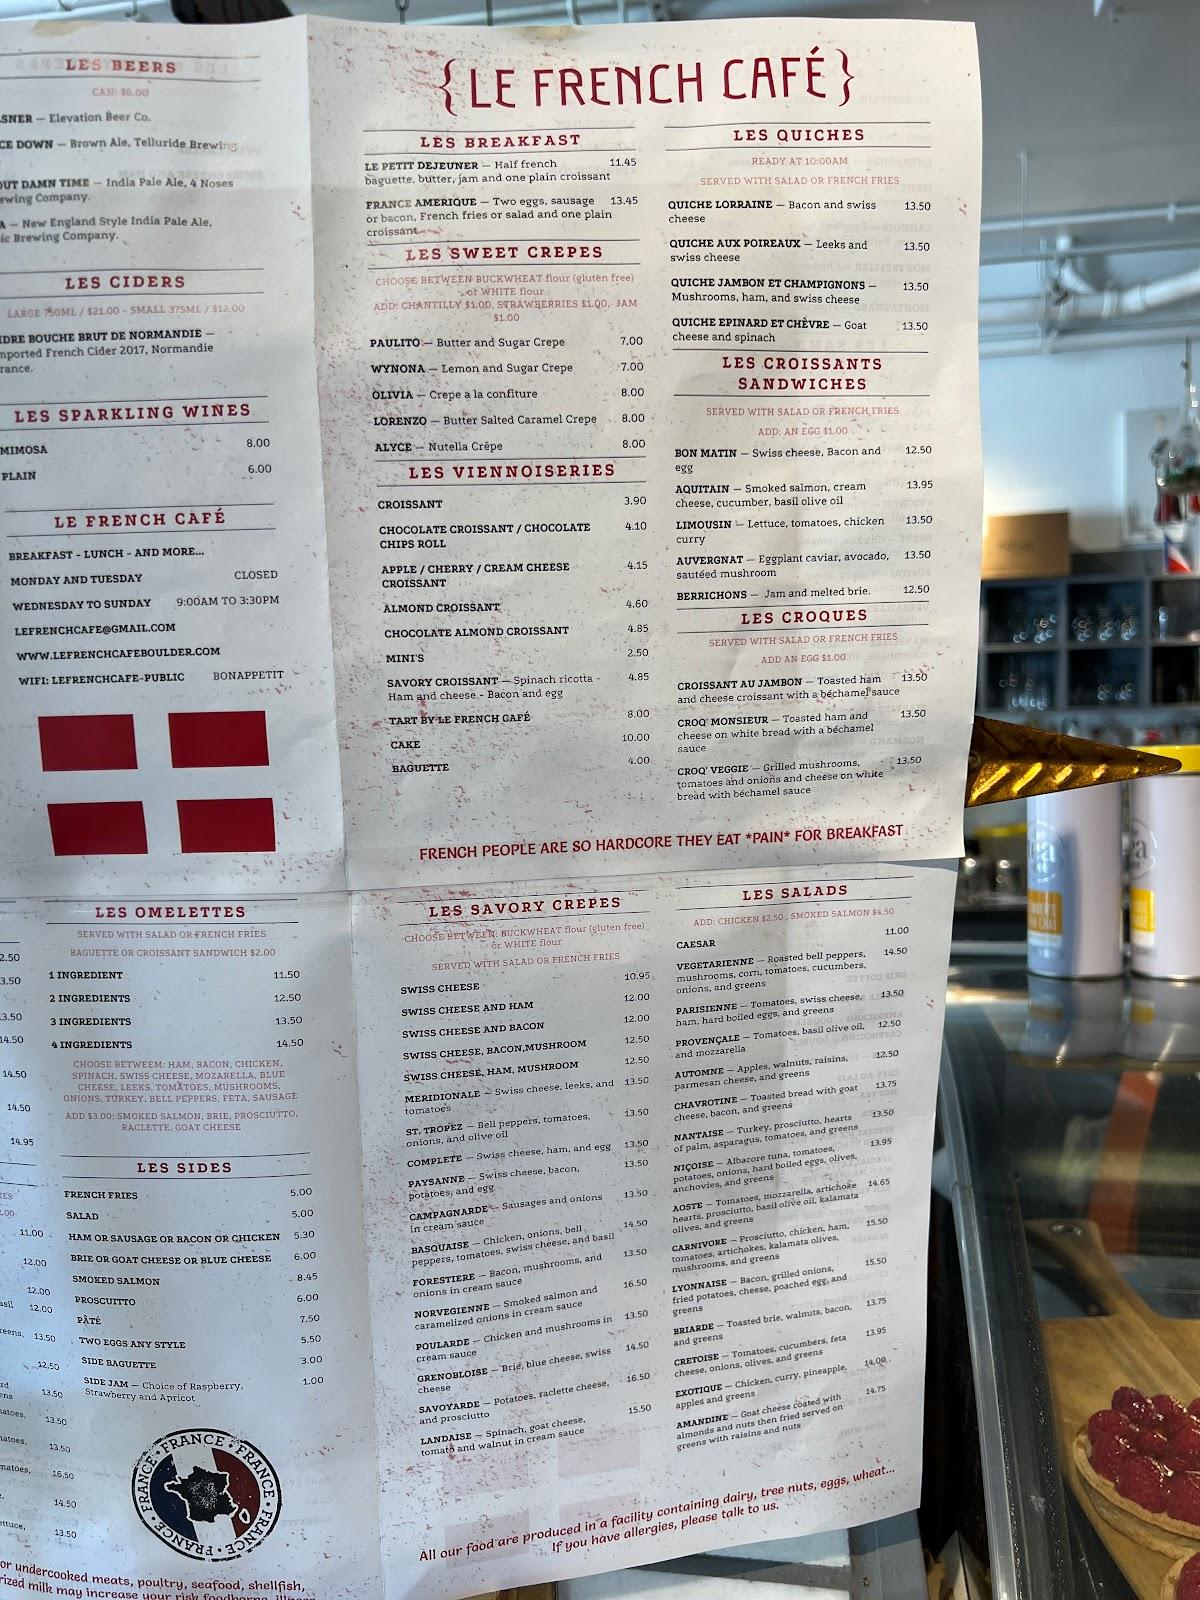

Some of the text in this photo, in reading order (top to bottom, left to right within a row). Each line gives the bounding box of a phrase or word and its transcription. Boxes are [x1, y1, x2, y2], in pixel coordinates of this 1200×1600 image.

[65, 58, 176, 74] LES BEERS
[534, 62, 703, 106] FRENCH
[48, 110, 151, 123] Elevation Beer Co.
[420, 134, 580, 149] LES BREAKFAST
[733, 128, 864, 144] LES QUICHES
[751, 155, 848, 168] READY AT 10:00AM
[667, 199, 931, 211] QUICHE LORRAINE Bacon and swiss 13.50
[406, 245, 602, 261] LES SWEET CREPES
[64, 275, 184, 290] LES CIDERS
[671, 317, 716, 328] QUICHE
[718, 317, 768, 328] EPINARD
[770, 318, 785, 328] ET
[844, 320, 867, 330] Goat
[901, 321, 928, 331] 13.50
[370, 335, 644, 350] PAULITO Butter and Sugar Crepe 7.00
[722, 356, 882, 370] LES CROISSANTS
[738, 377, 866, 390] SANDWICHES
[14, 402, 250, 423] LES SPARKLING WINES
[1, 463, 272, 481] PLAIN 6.00
[408, 463, 614, 480] LES VIENNOISERIES
[377, 495, 647, 510] CROISSANT 3.90
[53, 508, 225, 528] LE FRENCH CAFÉ
[8, 550, 73, 561] BREAKFAST
[83, 548, 124, 559] LUNCH
[134, 547, 160, 557] AND
[10, 570, 278, 586] MONDAY AND TUESDAY CLOSED
[676, 584, 930, 601] BERRICHONS Jam and melted brie. 12.50
[12, 594, 280, 611] WEDNESDAY TO SUNDAY 9:00AM TO 3:30PM
[382, 598, 650, 613] ALMOND CROISSANT 4.60
[740, 608, 867, 625] LES CROQUES
[14, 622, 176, 636] LEFRENCHCAFE@GMAIL.COM
[15, 646, 220, 661] WWW.LEFRENCHCAFEBOULDER.COM
[385, 648, 649, 663] MINI'S 2.50
[17, 669, 284, 686] WIFI: LEFRENCHCAFE-PUBLIC BONAPPETIT
[419, 845, 477, 860] FRENCH
[482, 843, 536, 857] PEOPLE
[540, 840, 568, 854] ARE
[572, 839, 592, 853] SO
[595, 835, 672, 851] HARDCORE
[675, 834, 713, 847] THEY
[716, 831, 742, 846] EAT
[794, 825, 822, 842] FOR
[826, 823, 904, 842] BREAKFAST
[742, 885, 848, 901] LES SALADS
[95, 906, 245, 918] LES OMELETTES
[428, 897, 622, 918] LES SAVORY CREPES
[676, 926, 910, 950] CAESAR 11.00
[56, 970, 123, 979] INGREDIENT
[273, 970, 300, 979] 11.50
[401, 992, 650, 1017] SWISS CHEESE AND HAM 12.00
[51, 1038, 304, 1049] 4 INGREDIENTS 14.50
[136, 1162, 232, 1174] LES SIDES
[63, 1187, 312, 1200] FRENCH FRIES 5.00
[413, 1277, 648, 1319] NORVEGIENNE Smoked salmon and 16.50
[299, 1313, 320, 1324] 7.50
[673, 1326, 887, 1366] CRETOISE 13.95
[160, 1433, 225, 1454] FRANCE
[234, 1444, 275, 1498] FRANCE
[138, 1456, 158, 1512] FRANCE
[419, 1549, 436, 1561] All
[440, 1546, 463, 1558] our
[467, 1540, 494, 1555] food
[498, 1536, 519, 1547] are
[523, 1523, 581, 1544] produced
[585, 1520, 596, 1531] in
[600, 1520, 608, 1528] a
[611, 1511, 653, 1528] facility
[657, 1498, 719, 1516] containing
[723, 1490, 757, 1504] dairy,
[761, 1485, 784, 1497] tree
[788, 1481, 817, 1493] nuts,
[820, 1478, 850, 1490] eggs,
[552, 1501, 779, 1552] If you have allergies, please talk to us.
[154, 1524, 213, 1556] FRANCE
[225, 1509, 273, 1555] FRANCE
[15, 1563, 88, 1583] undercooked
[92, 1575, 134, 1588] meats,
[137, 1576, 188, 1590] poultry,
[191, 1579, 244, 1592] seafood,
[248, 1580, 305, 1593] shellfish,
